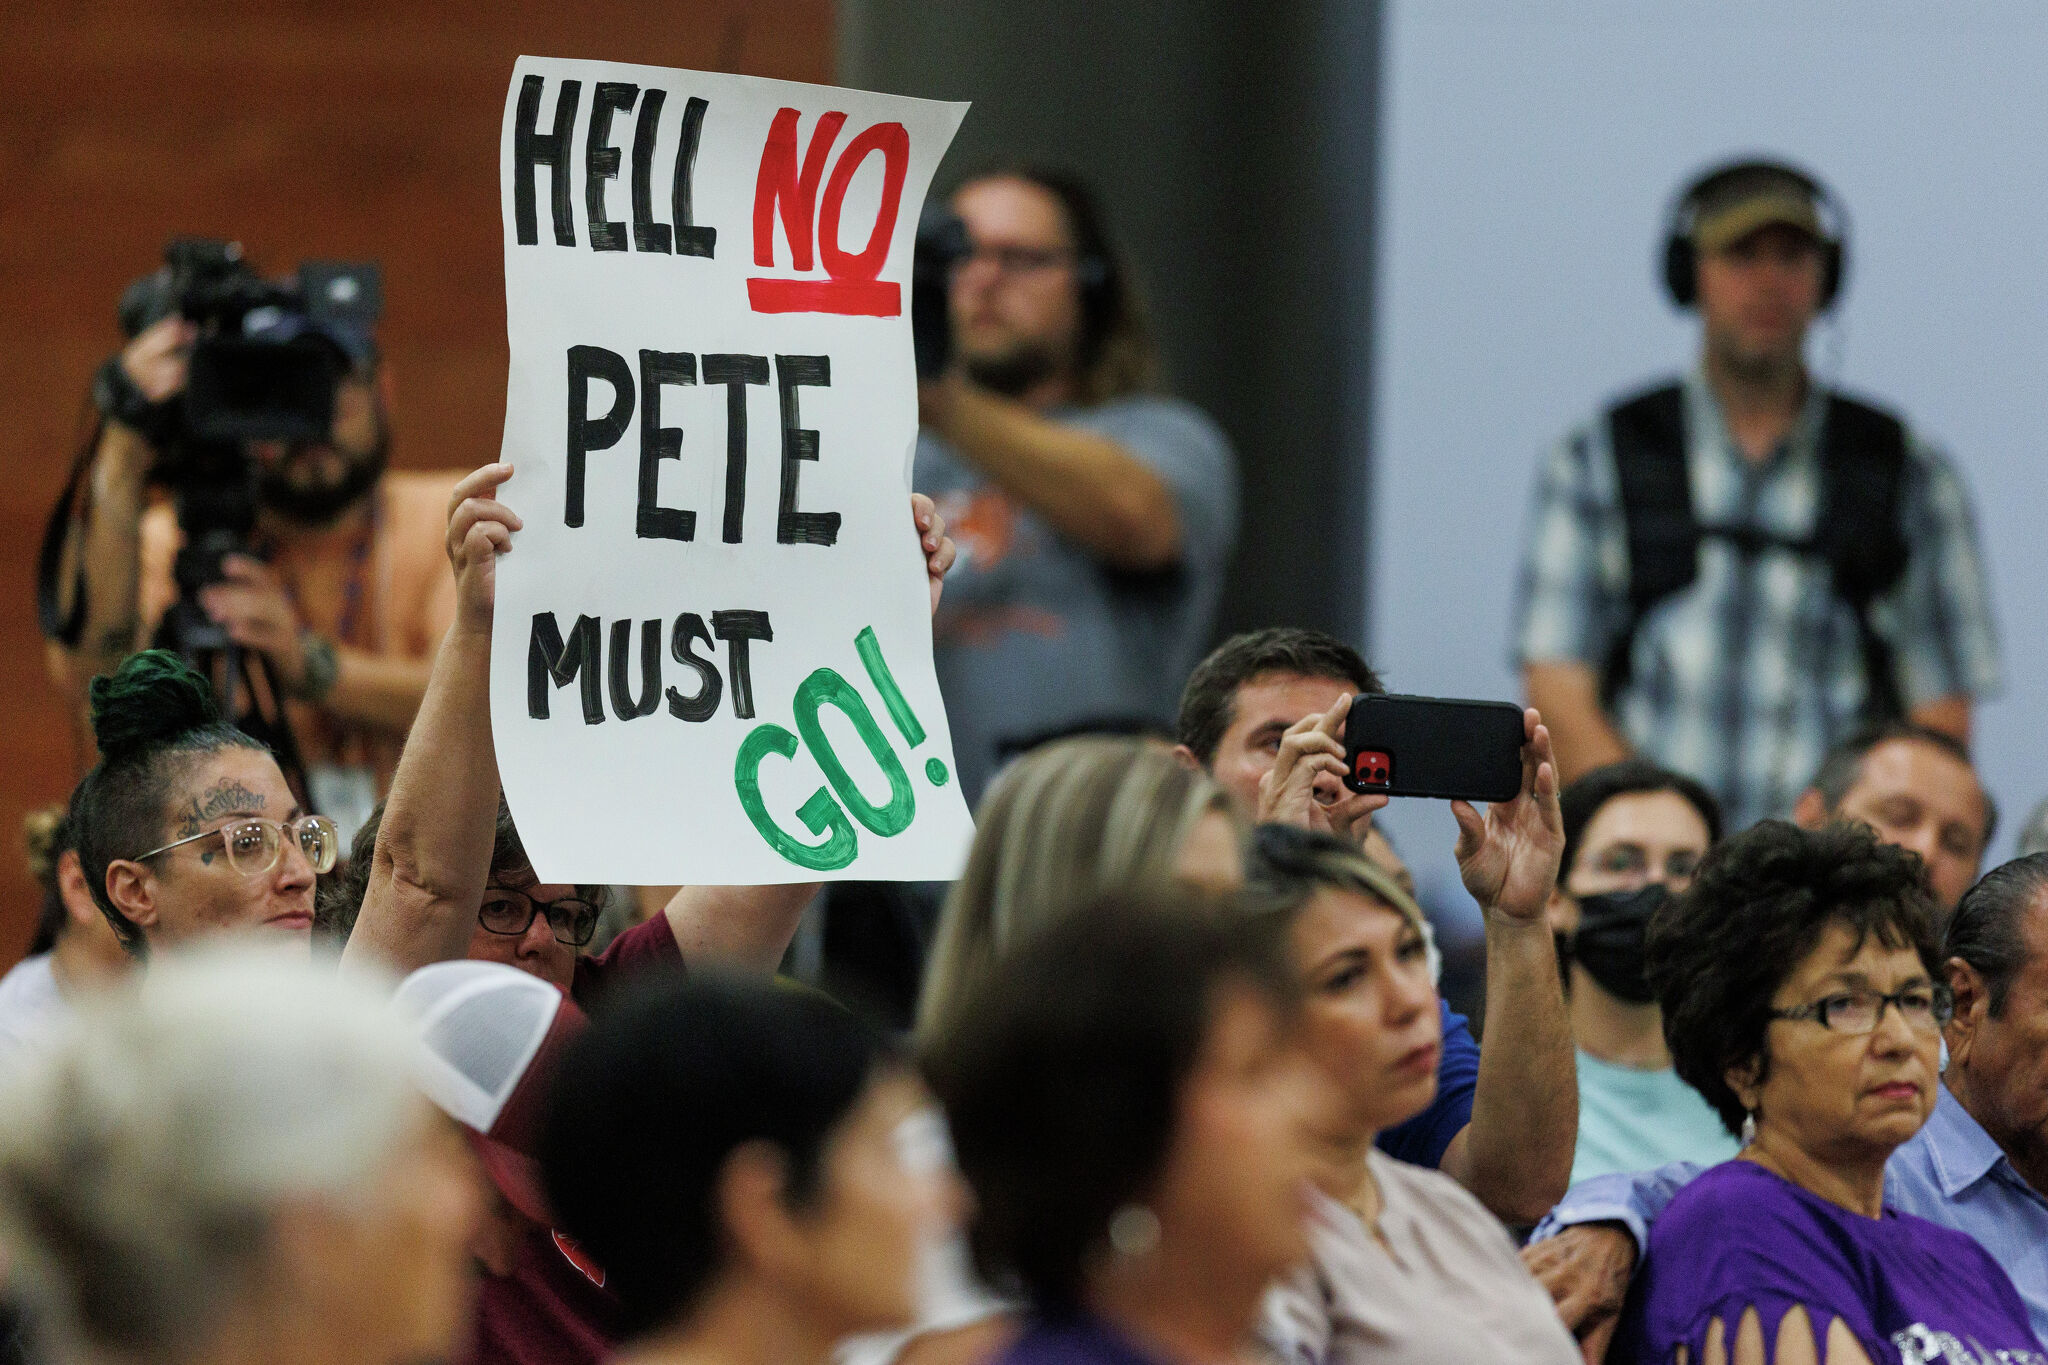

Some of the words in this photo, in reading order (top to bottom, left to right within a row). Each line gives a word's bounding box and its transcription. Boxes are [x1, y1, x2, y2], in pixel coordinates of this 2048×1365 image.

[514, 75, 716, 259] HELL
[753, 108, 909, 280] NO
[564, 345, 841, 547] PETE
[528, 610, 773, 725] MUST
[735, 626, 948, 871] GO!
